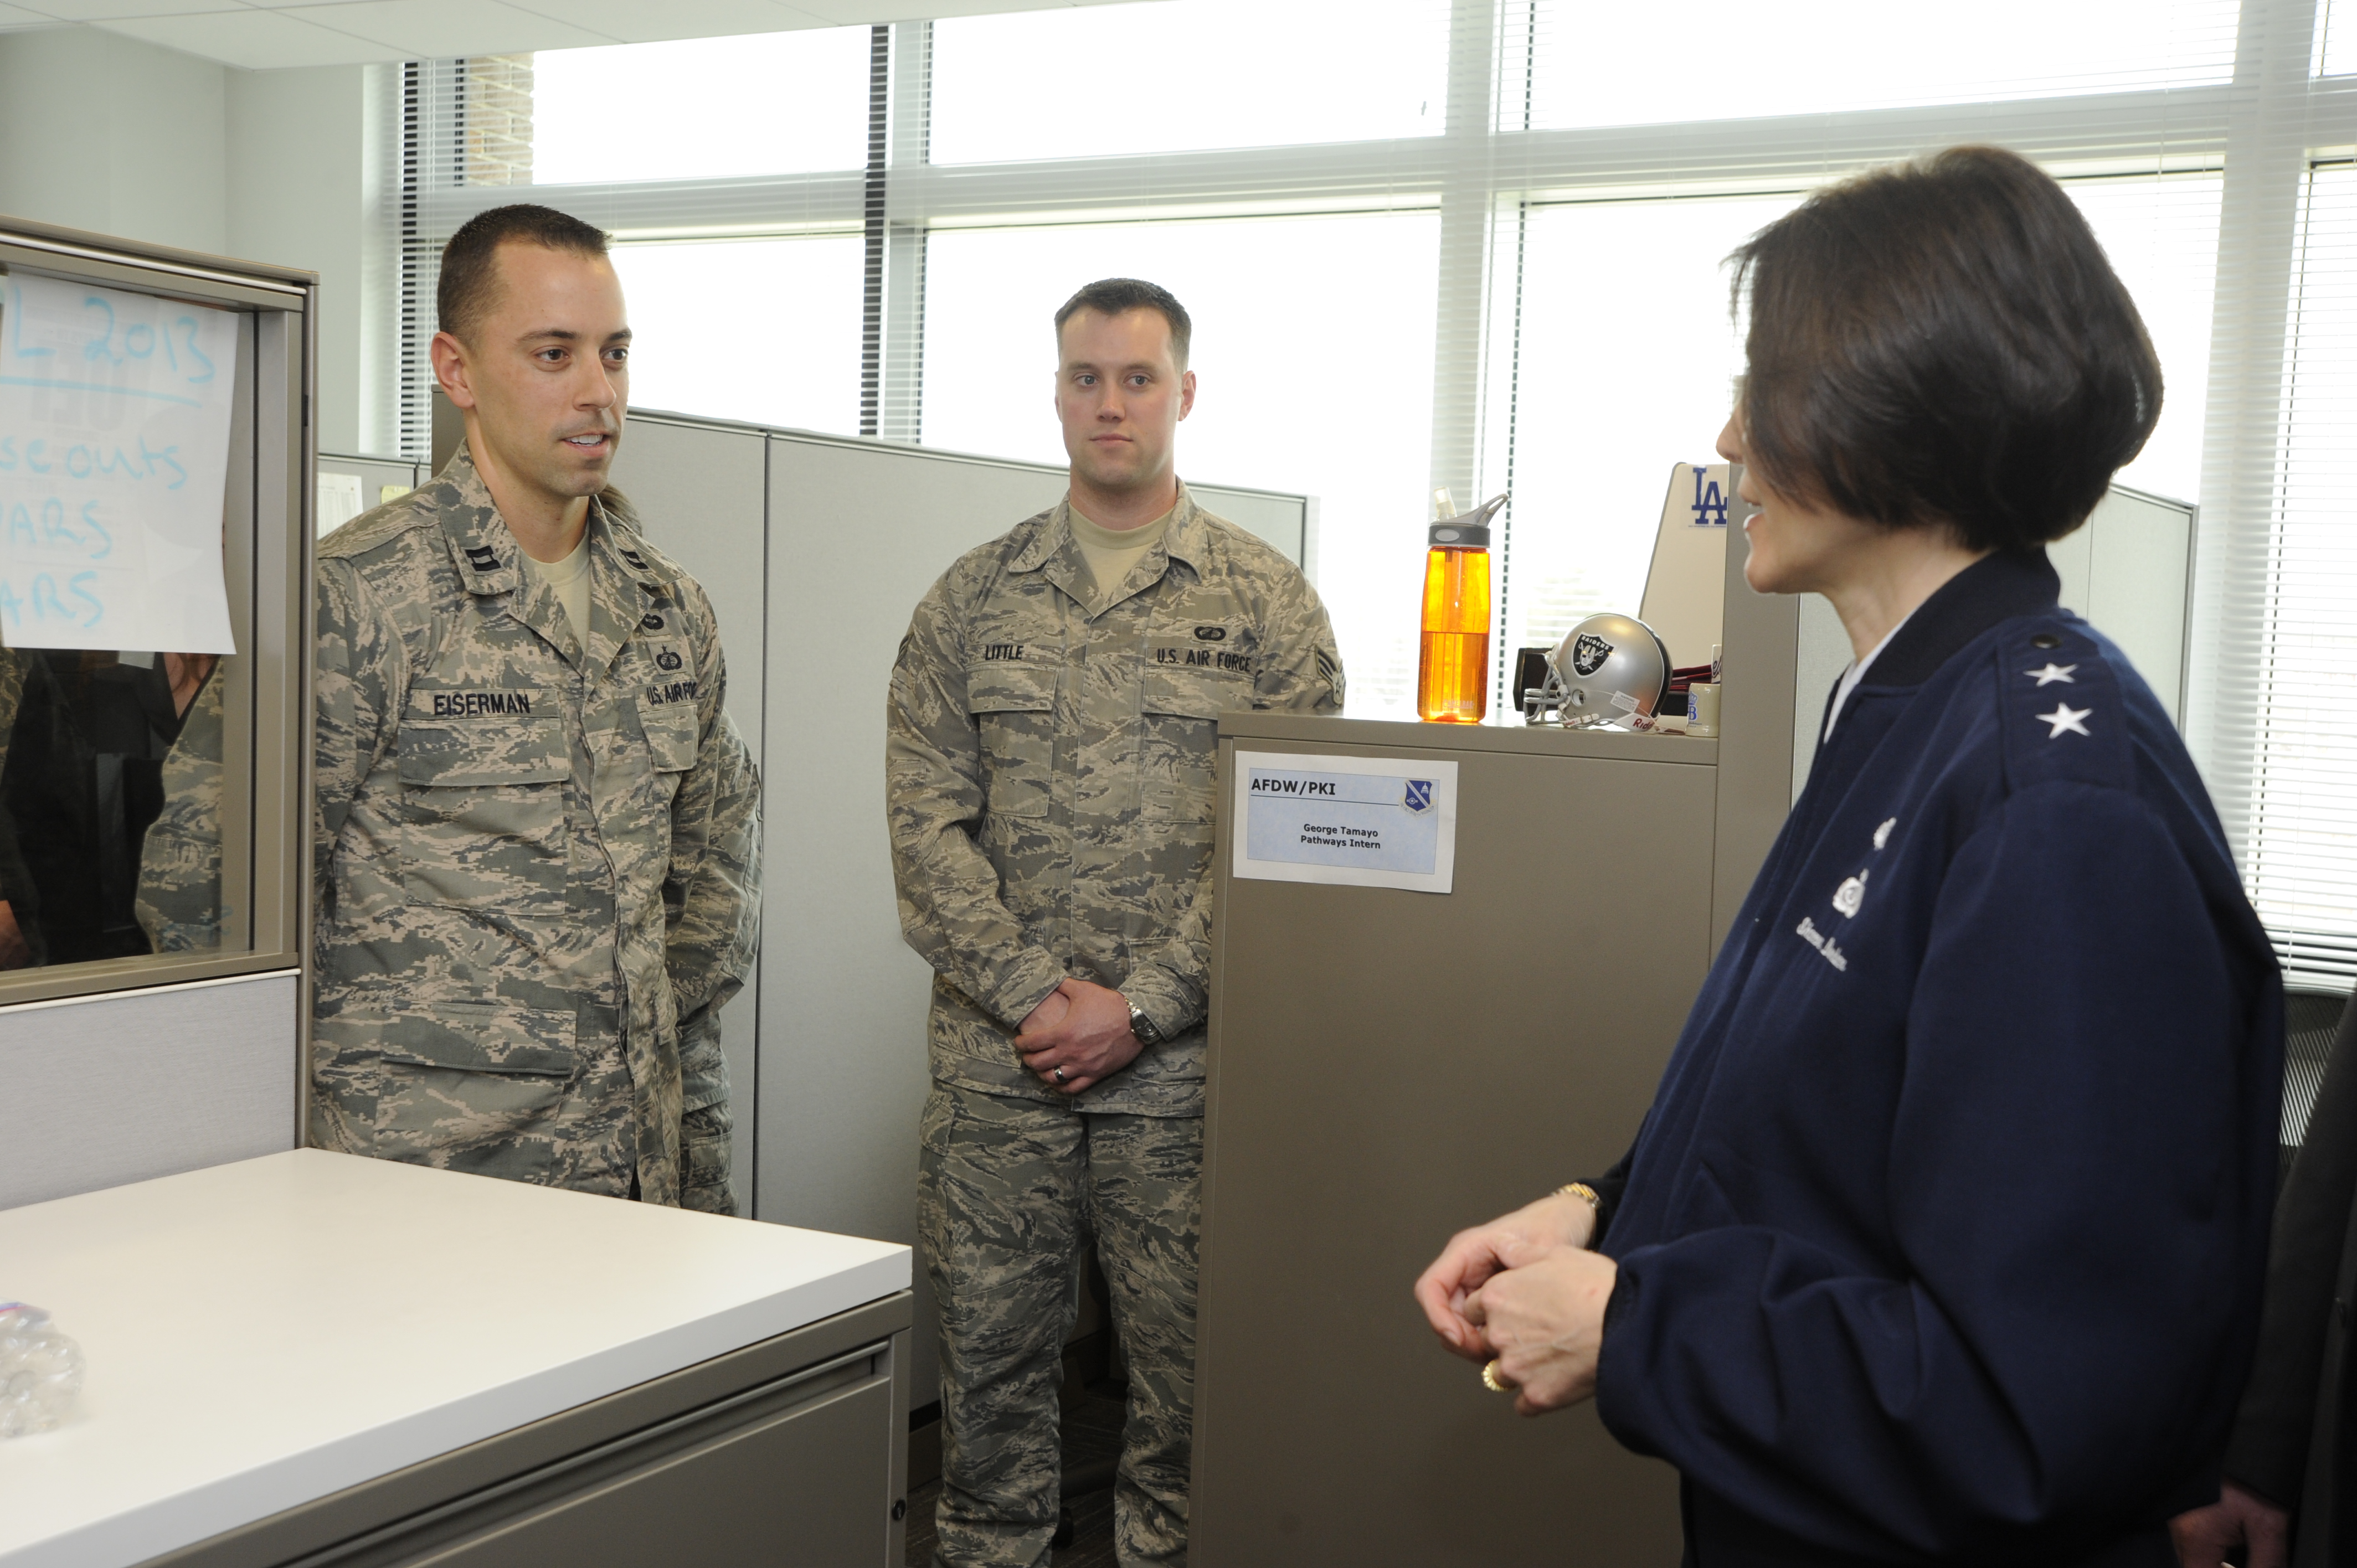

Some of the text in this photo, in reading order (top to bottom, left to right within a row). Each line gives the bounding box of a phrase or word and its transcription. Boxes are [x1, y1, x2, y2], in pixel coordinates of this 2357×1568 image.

[84, 296, 216, 384] 2013
[1691, 467, 1727, 524] LA
[0, 497, 112, 559] ARS
[985, 644, 1023, 660] LITTLE
[1581, 636, 1610, 650] RAIDERS
[1157, 649, 1251, 672] U.S. AIR FORCE
[434, 693, 530, 715] EISERMAN
[665, 682, 683, 704] AIR
[1251, 778, 1336, 795] AFDW/PKI
[1301, 835, 1381, 849] Pathways Intern
[1304, 824, 1378, 838] George Tamayo
